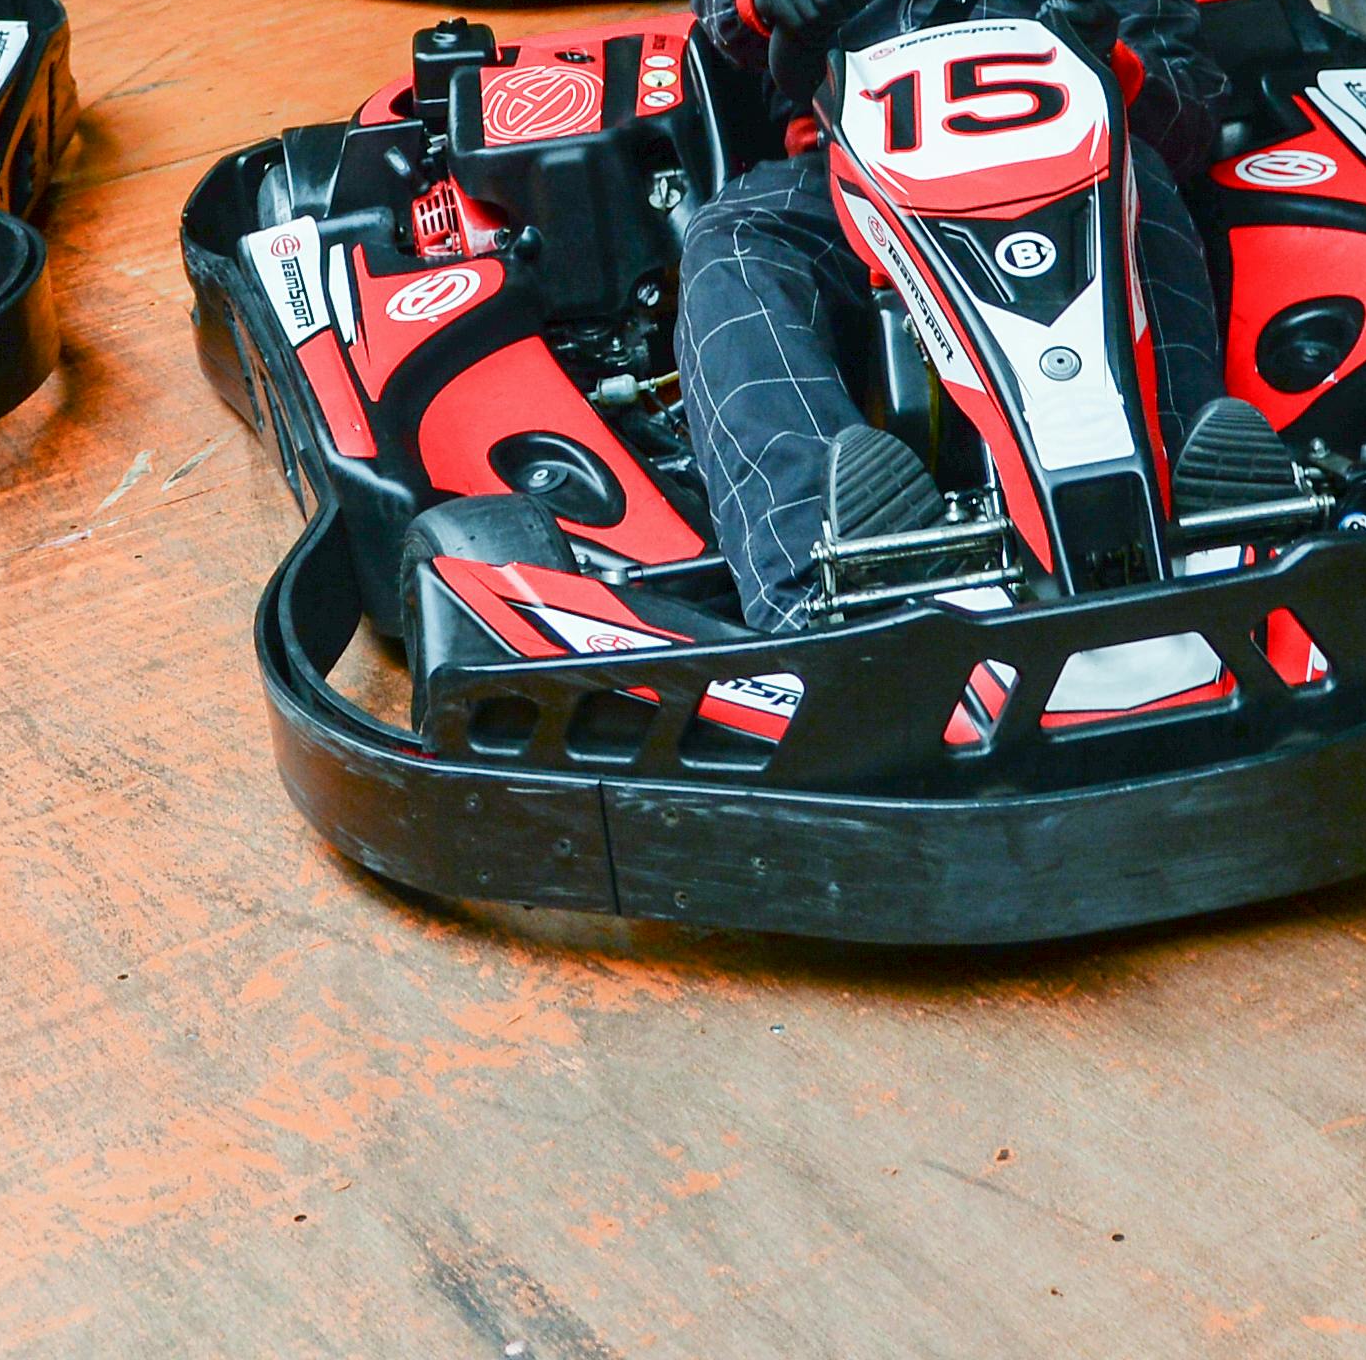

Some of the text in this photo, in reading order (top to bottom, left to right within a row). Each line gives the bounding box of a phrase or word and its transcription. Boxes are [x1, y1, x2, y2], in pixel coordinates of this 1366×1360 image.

[858, 46, 1071, 155] 15
[280, 255, 316, 329] TeamSport
[886, 239, 955, 365] TeamSport
